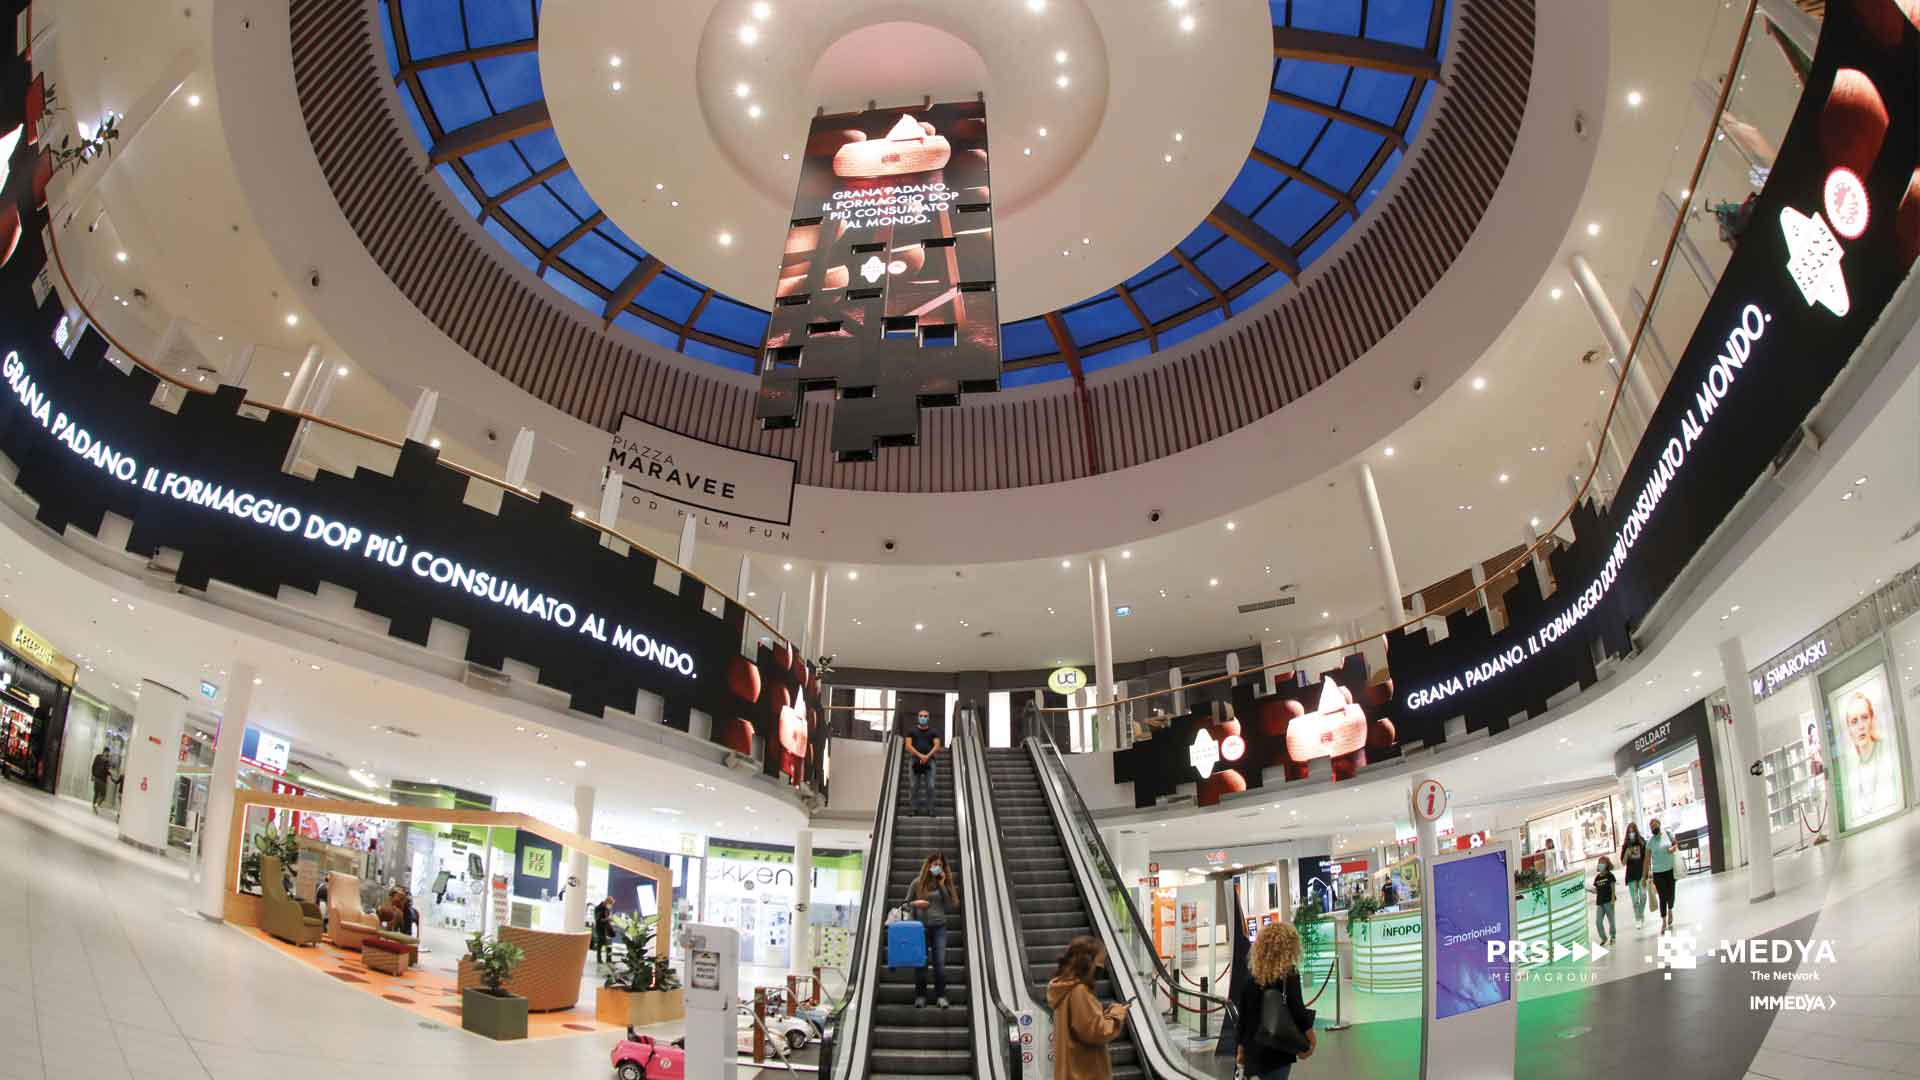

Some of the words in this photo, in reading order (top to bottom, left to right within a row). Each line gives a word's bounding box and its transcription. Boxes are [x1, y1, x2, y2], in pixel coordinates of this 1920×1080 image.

[822, 203, 832, 212] IL
[836, 195, 925, 209] FORMAGGIO
[929, 191, 960, 202] DOP
[832, 188, 882, 201] GRANA
[884, 182, 950, 195] PADANO.
[830, 208, 852, 221] PIÙ
[855, 202, 949, 218] CONSUMATO
[846, 220, 864, 229] AL
[866, 214, 931, 227] MONDO.
[612, 435, 675, 466] PIAZZA
[608, 446, 737, 500] MARAVEE
[2, 350, 52, 429] GRANA
[50, 412, 138, 485] PADANO.
[142, 467, 160, 493] IL
[160, 472, 302, 533] FORMAGGIO
[304, 513, 363, 552] DOP
[364, 534, 408, 568] PIÙ
[411, 550, 577, 628] CONSUMATO
[580, 613, 607, 642] AL
[612, 624, 698, 679] MONDO.
[601, 484, 658, 510] FOD
[677, 509, 730, 530] FLM
[749, 525, 791, 541] FUN
[1406, 676, 1464, 711] GRANA
[1465, 644, 1529, 688] PADANO.
[1527, 635, 1542, 656] IL
[1541, 579, 1604, 648] FORMAGGIO
[1600, 554, 1618, 593] DOP
[1622, 437, 1684, 549] CONSUMATO
[1679, 409, 1705, 454] AL
[1695, 303, 1773, 423] MONDO.
[1766, 639, 1828, 688] SWAROVSKI
[1634, 721, 1672, 751] GOLDART
